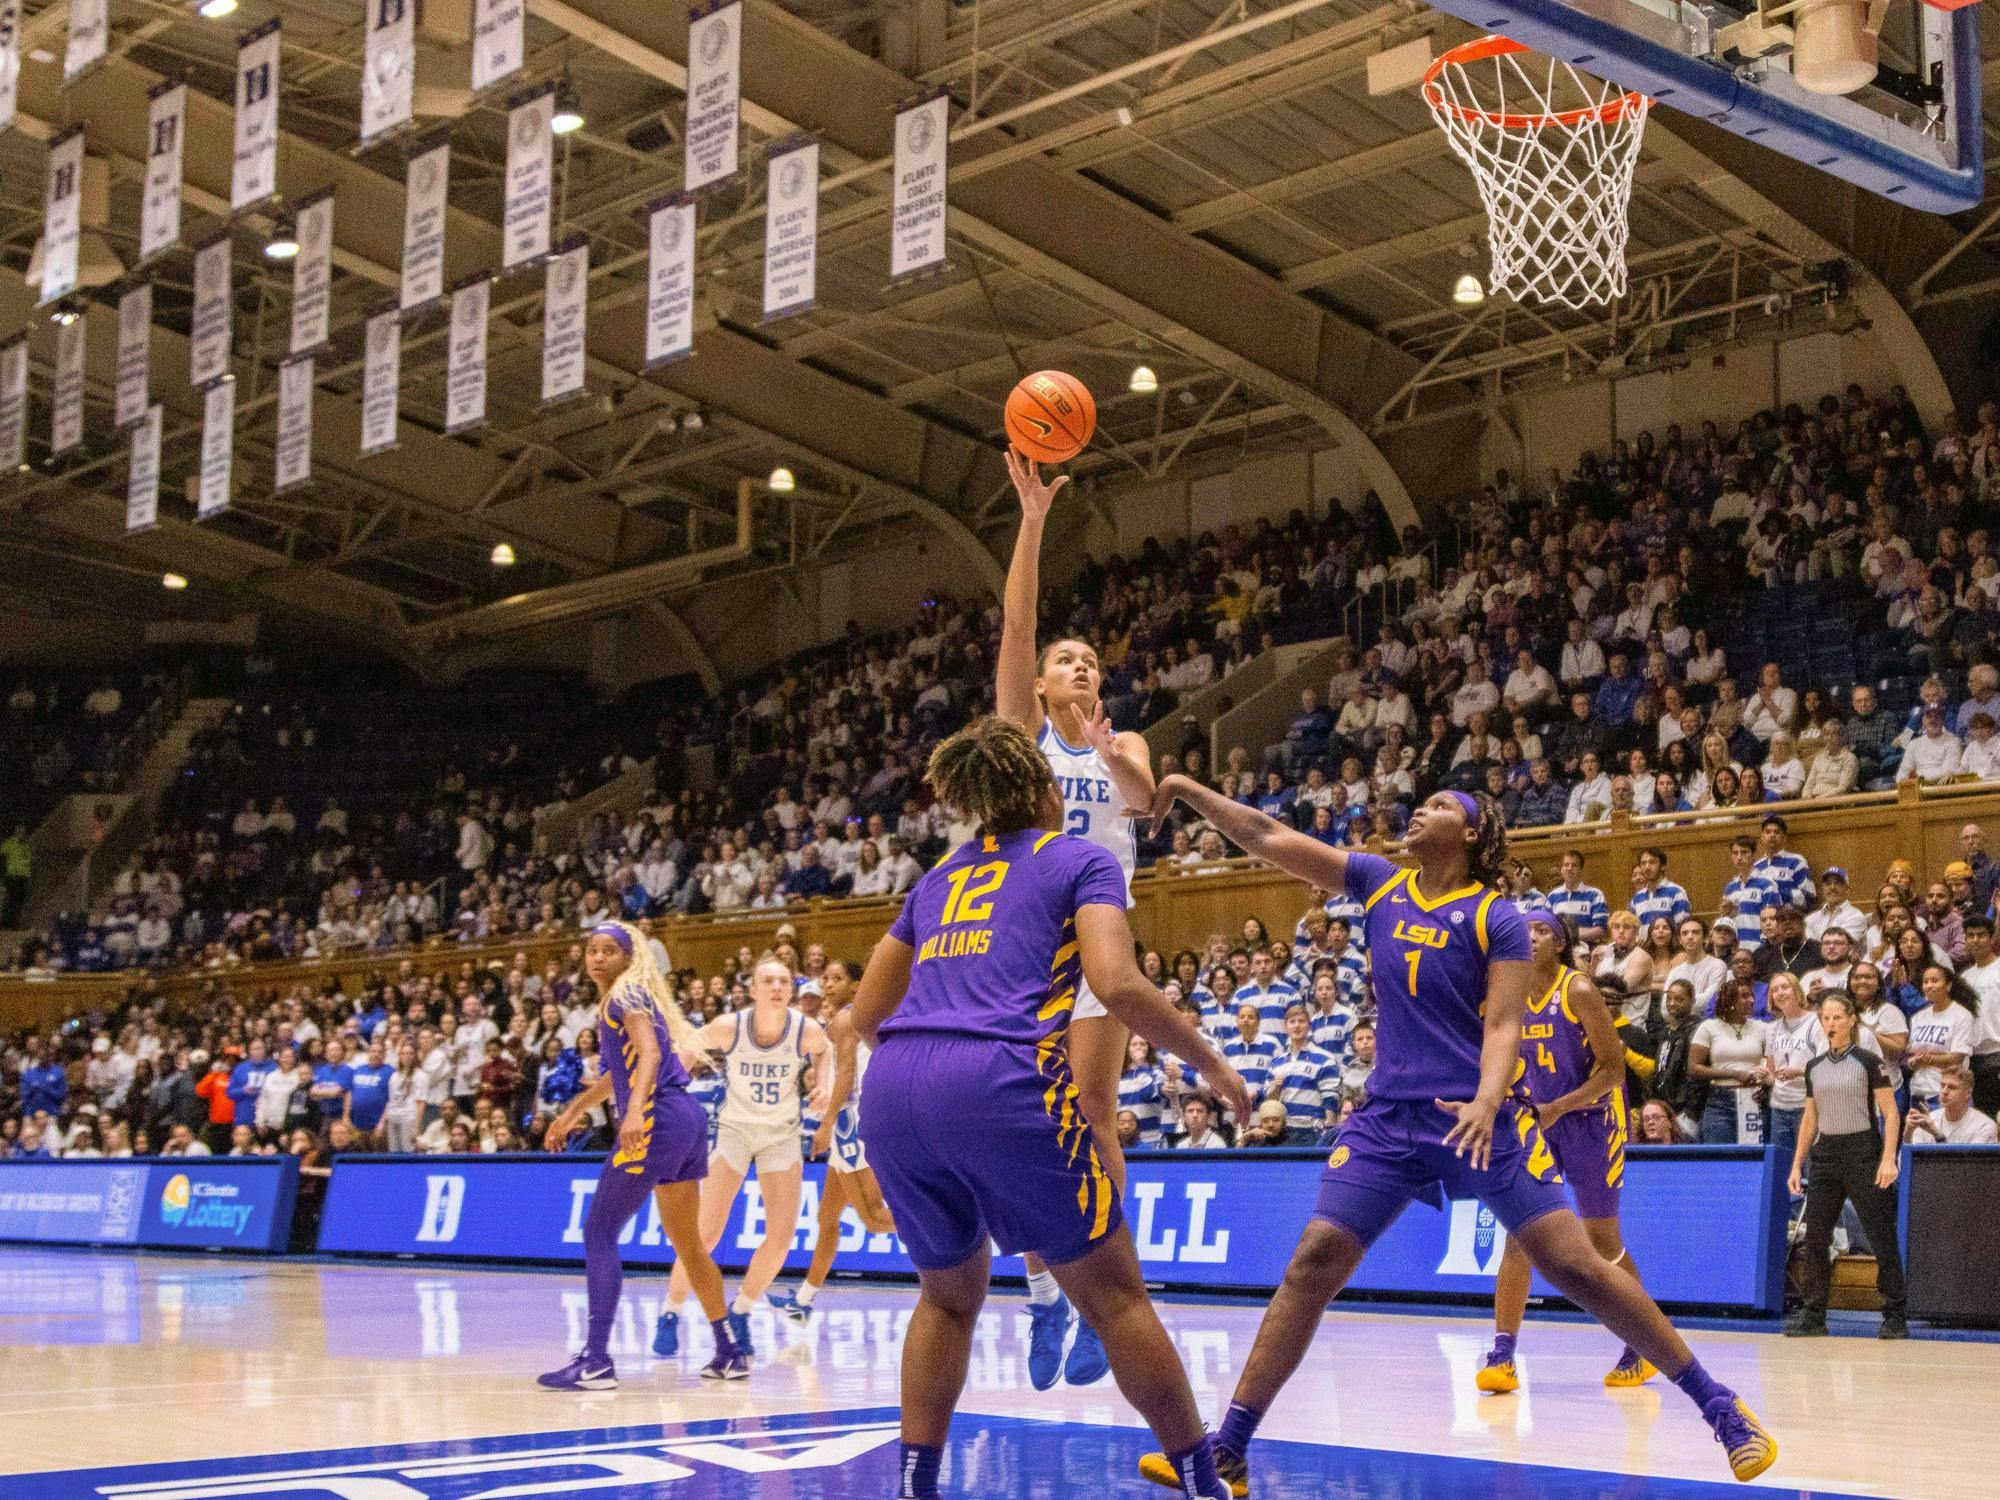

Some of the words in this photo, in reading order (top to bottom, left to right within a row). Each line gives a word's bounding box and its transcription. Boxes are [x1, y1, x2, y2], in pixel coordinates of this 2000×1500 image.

[687, 101, 737, 132] CONFERENCE
[688, 118, 734, 146] CHAMPIONS
[902, 163, 938, 186] ATLANTIC
[895, 190, 944, 217] CONFERENCE
[907, 180, 932, 199] COAST
[895, 207, 942, 233] CHAMPIONS
[1031, 376, 1073, 417] ELITE
[1056, 774, 1110, 804] UKE
[1067, 808, 1090, 836] 2
[940, 860, 1010, 925] 12
[916, 929, 993, 965] WILLIAMS
[1392, 919, 1450, 949] LSU
[1404, 949, 1422, 997] 1
[1521, 1023, 1554, 1040] LSU
[740, 1061, 791, 1080] DUKE
[1537, 1042, 1556, 1074] 4
[750, 1081, 781, 1105] 35
